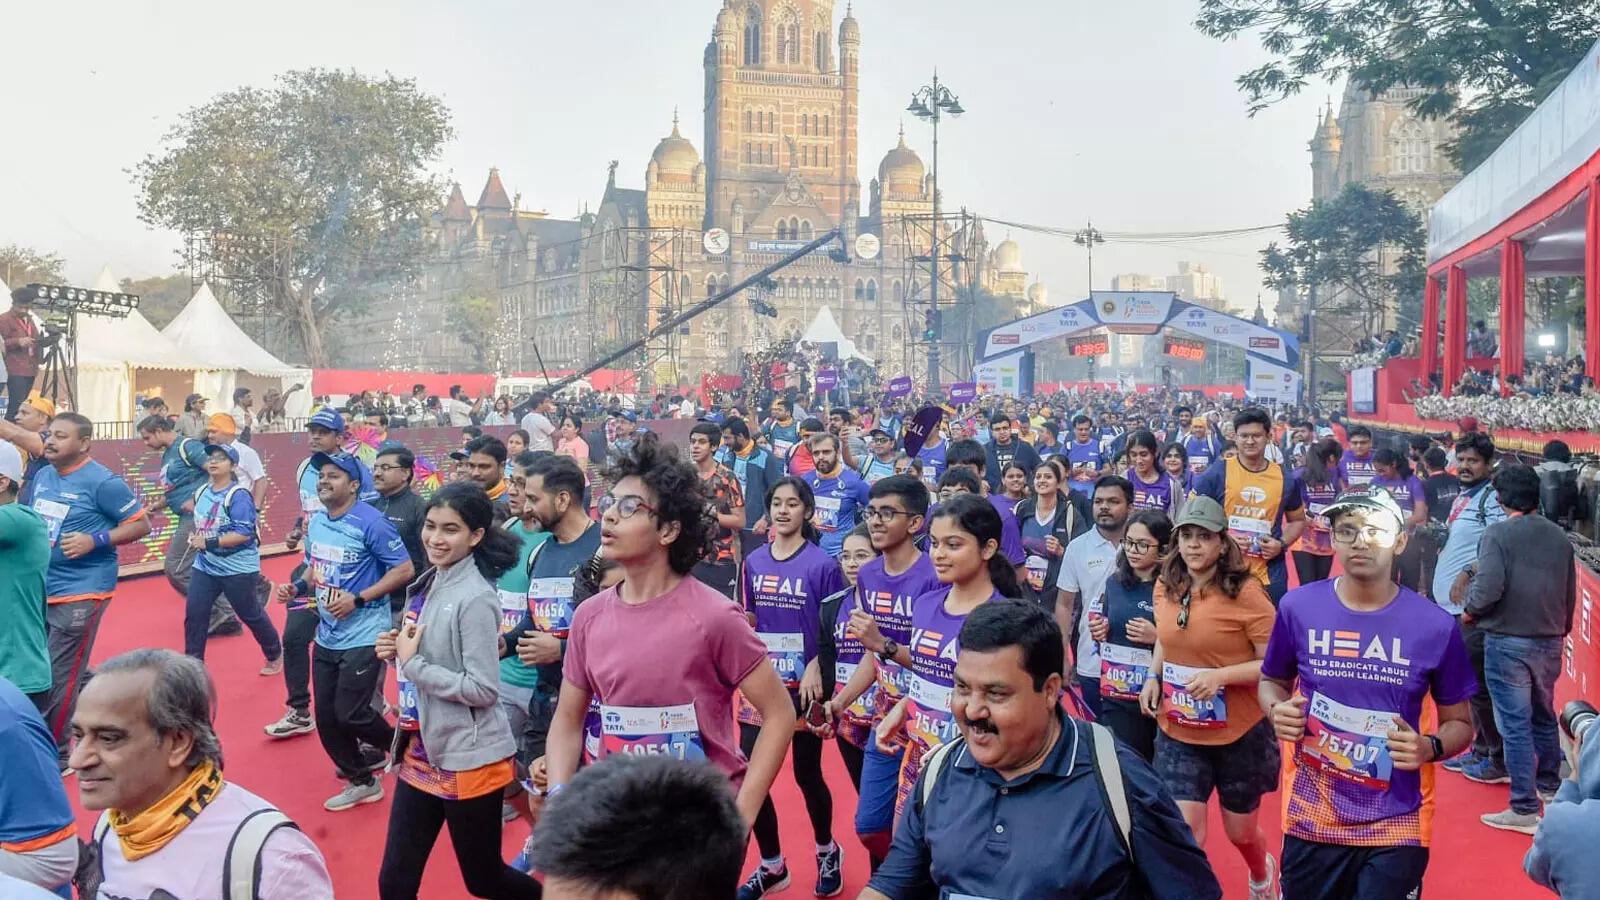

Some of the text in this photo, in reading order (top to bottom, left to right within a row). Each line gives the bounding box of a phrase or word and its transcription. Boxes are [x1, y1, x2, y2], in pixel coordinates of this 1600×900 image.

[1060, 319, 1079, 327] TATA
[1187, 320, 1207, 328] TATA
[909, 421, 924, 437] EAL
[1134, 490, 1164, 506] EAL
[1234, 504, 1267, 516] TATA
[752, 574, 807, 597] HEAL
[910, 627, 958, 663] HEA
[1308, 628, 1410, 666] HEAL
[770, 658, 795, 672] 708
[916, 656, 952, 671] ERADICATE
[1309, 658, 1410, 678] HELP ERADICATE ABUSE
[1106, 667, 1143, 685] 60920
[1313, 667, 1403, 686] THROUGH LEARNING
[1312, 707, 1330, 720] TATA
[604, 724, 625, 732] TATA
[1317, 729, 1380, 764] 75707
[172, 769, 221, 821] TAT
